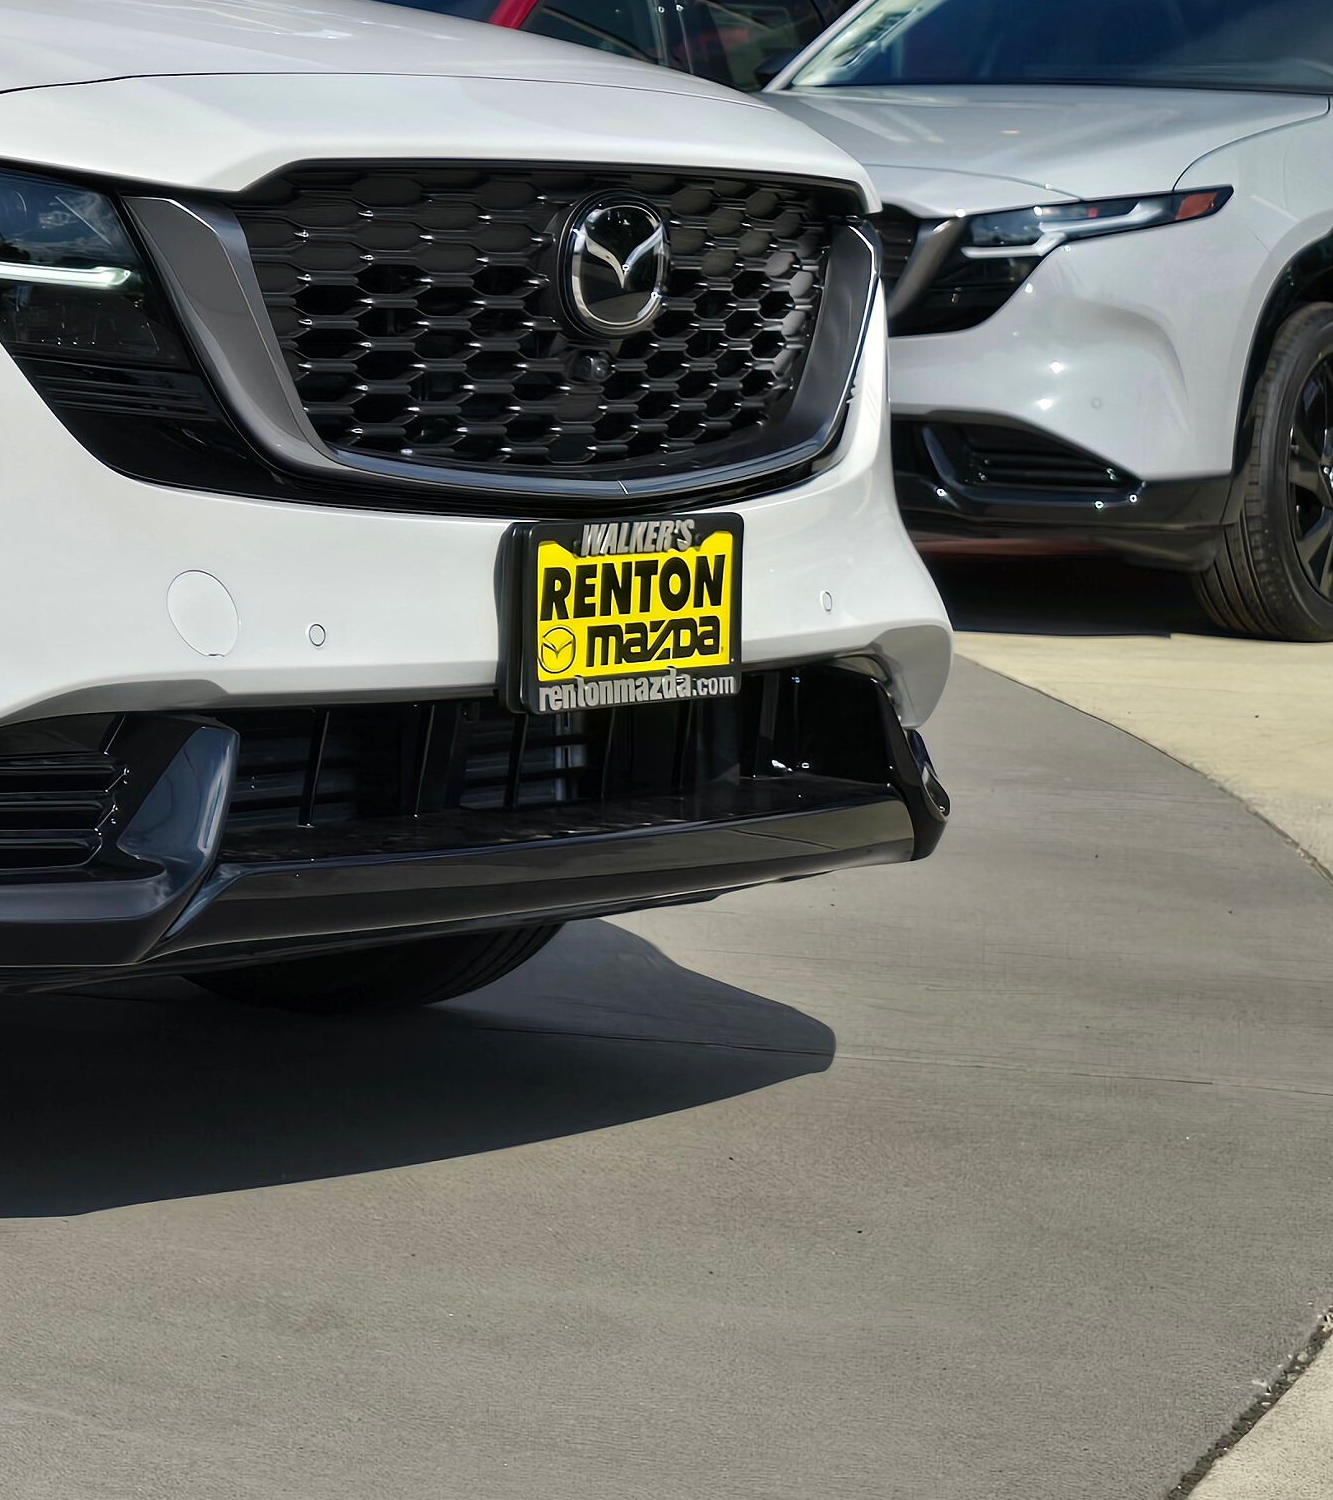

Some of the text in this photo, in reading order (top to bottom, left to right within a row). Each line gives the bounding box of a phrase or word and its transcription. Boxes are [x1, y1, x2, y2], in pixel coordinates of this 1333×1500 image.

[580, 518, 696, 557] WALKER'S
[540, 554, 726, 621] RENTON
[585, 615, 721, 668] mazda
[538, 665, 734, 712] rentonmazda.com
